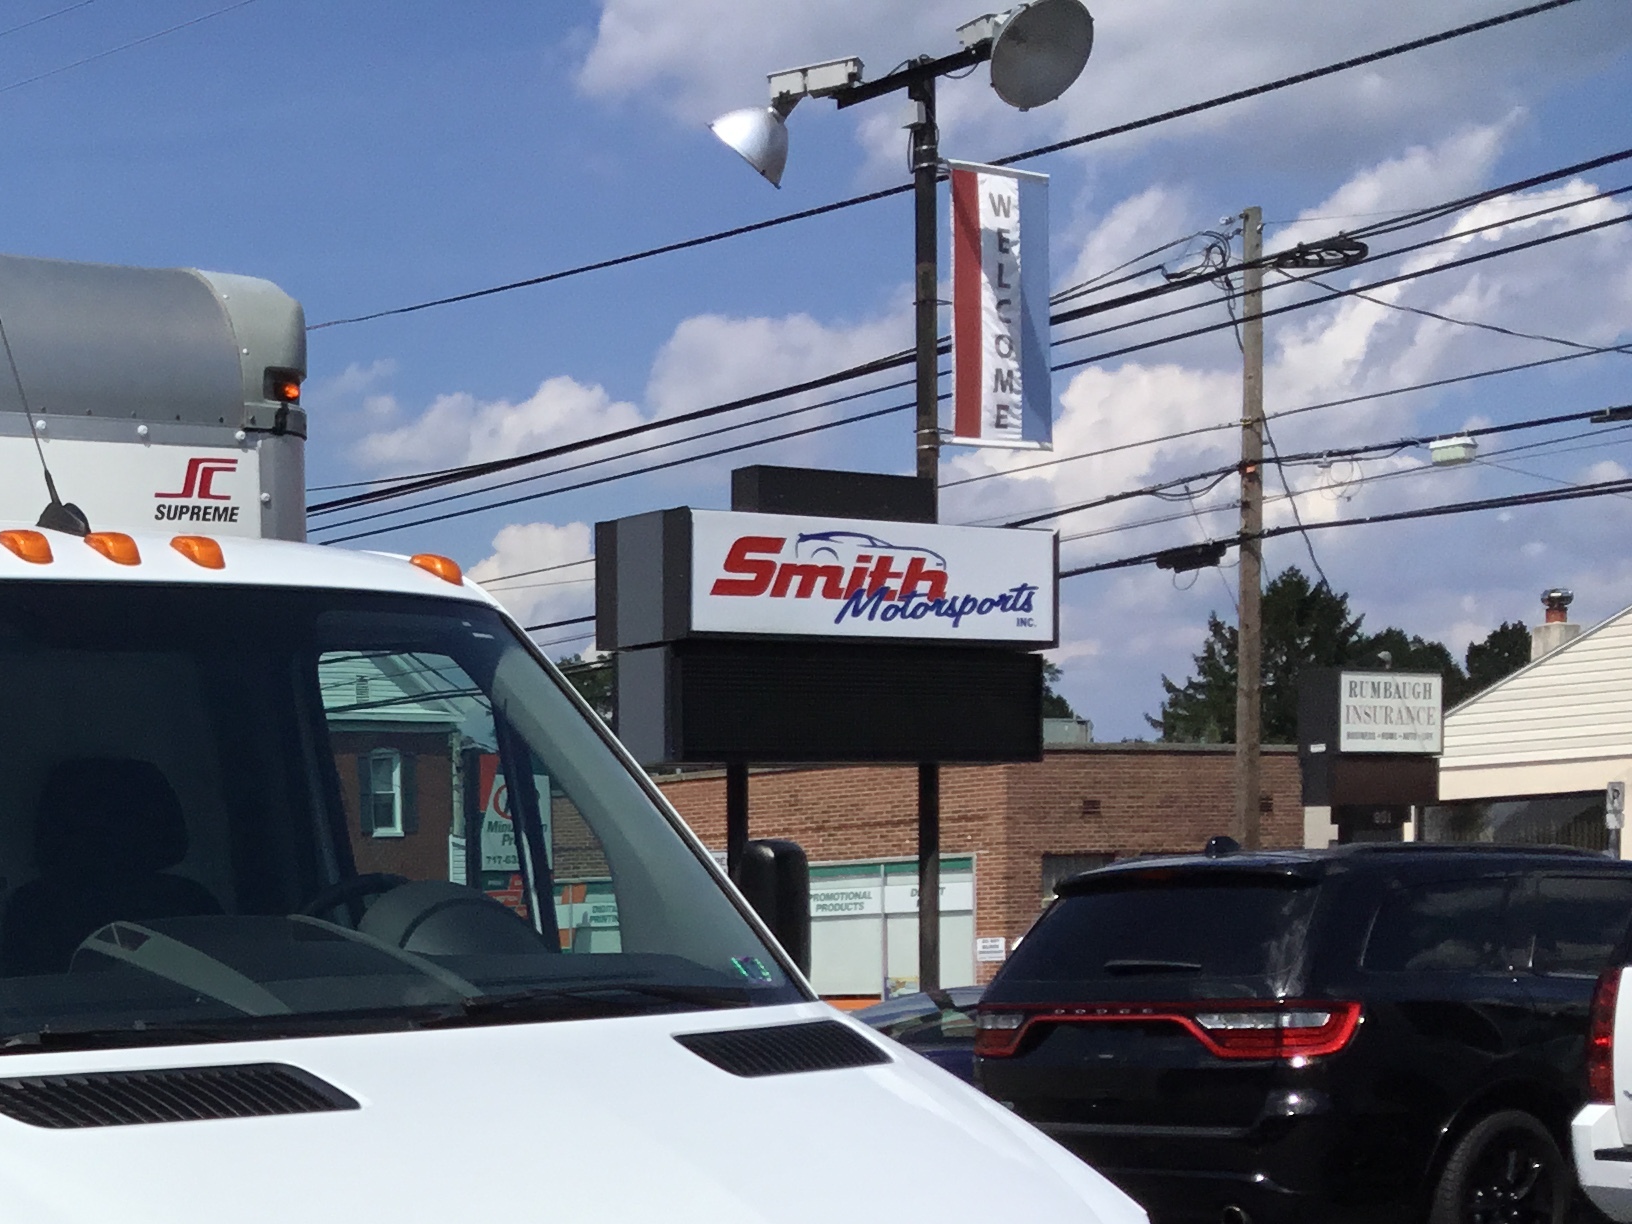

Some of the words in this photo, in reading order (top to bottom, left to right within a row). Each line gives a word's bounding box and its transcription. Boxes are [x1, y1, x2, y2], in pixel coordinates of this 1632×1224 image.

[988, 191, 1014, 430] WELCOME
[154, 503, 240, 523] SUPREME
[710, 535, 948, 603] Smith
[834, 582, 1040, 628] Motorsports
[1015, 616, 1038, 629] INC.
[1348, 680, 1433, 701] RUMBAUGH
[1344, 704, 1436, 726] INSURANCE
[816, 901, 865, 913] PRODUCTS
